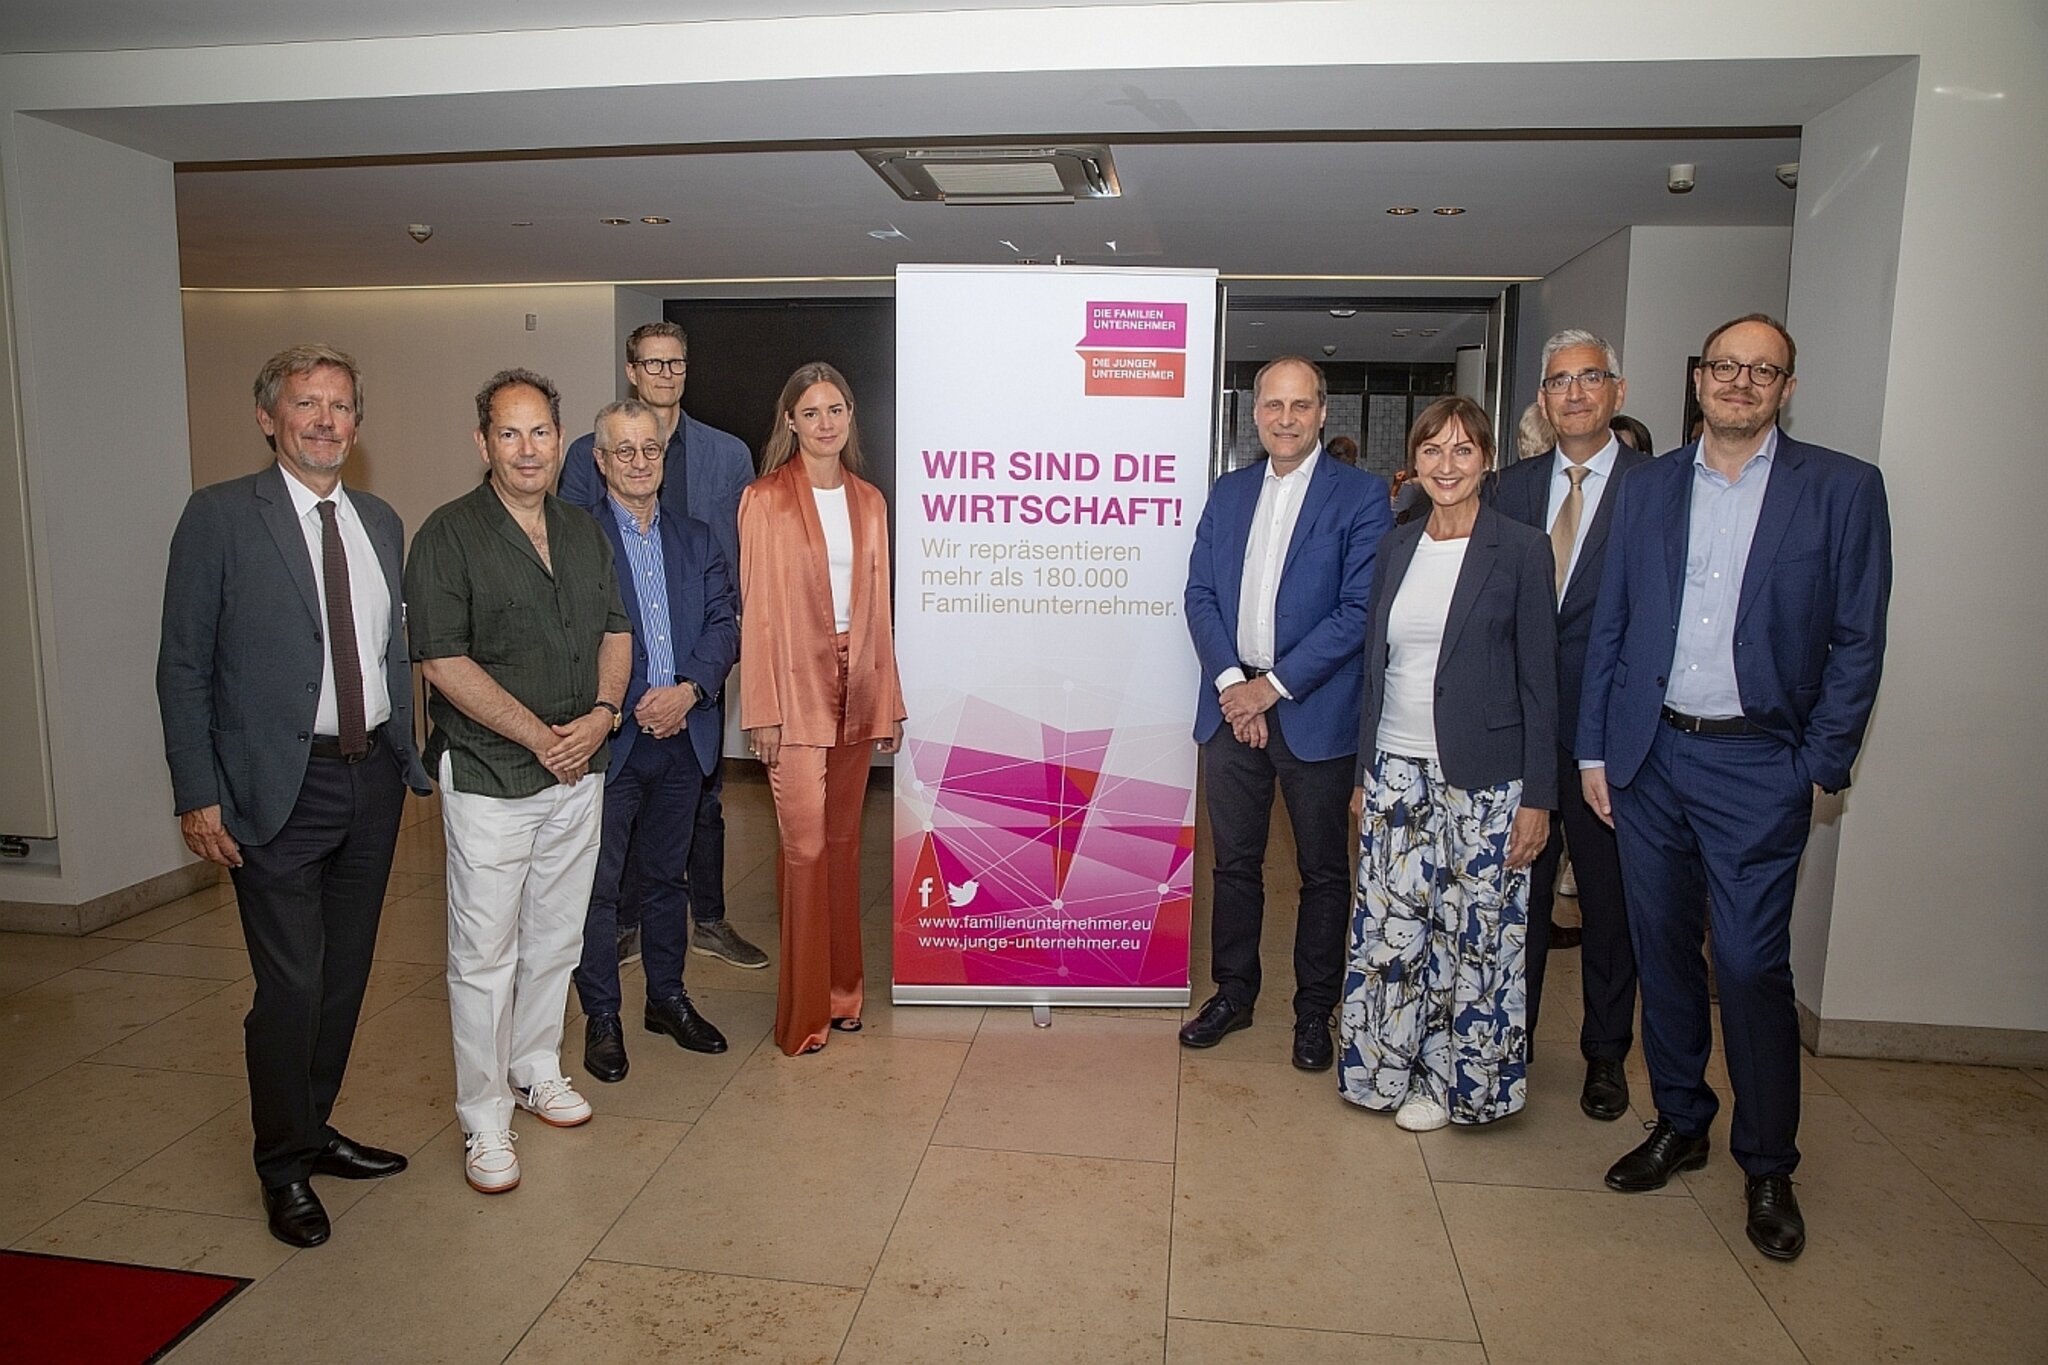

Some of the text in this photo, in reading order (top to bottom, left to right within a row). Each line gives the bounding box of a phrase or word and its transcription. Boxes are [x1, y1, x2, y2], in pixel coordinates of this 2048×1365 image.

[1093, 308, 1164, 320] DIE FAMILIEN
[1093, 319, 1176, 331] UNTERNEHMER
[1092, 358, 1157, 368] DIE JUNGEN
[1092, 369, 1175, 380] UNTERNEHMER
[921, 450, 1176, 483] WIR SIND DIE
[921, 494, 1182, 527] WIRTSCHAFT!
[921, 537, 1142, 564] Wir repräsentieren
[921, 566, 1129, 588] mehr als 180.000
[921, 591, 1177, 617] Familienunternehmer.
[918, 915, 1152, 931] www.familienunternehmer.eu
[918, 934, 1141, 952] www.junge-unternehmer.eu
